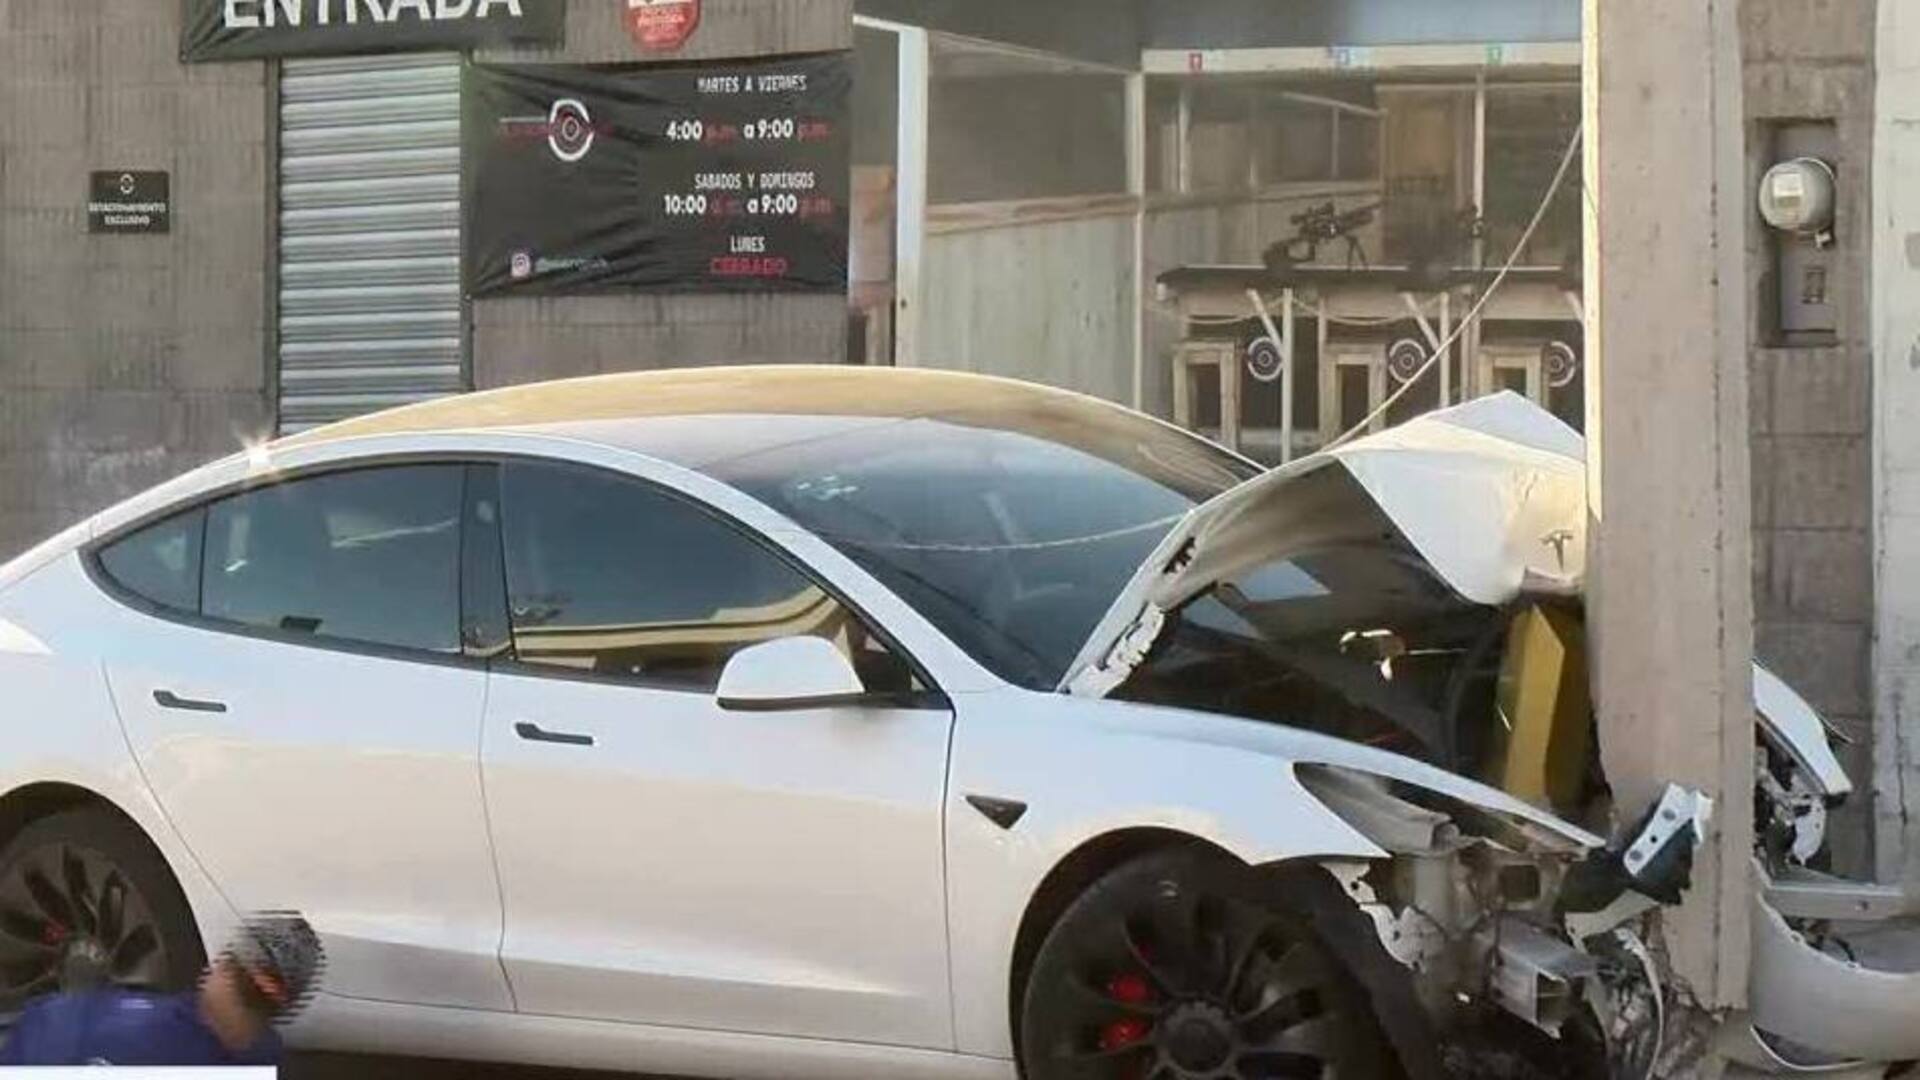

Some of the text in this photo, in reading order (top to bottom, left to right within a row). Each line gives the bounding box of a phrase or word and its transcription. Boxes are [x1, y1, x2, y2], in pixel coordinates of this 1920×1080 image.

[697, 75, 807, 93] MARTES A VIERNES
[666, 119, 703, 140] 4:00
[743, 124, 755, 139] a
[757, 118, 794, 139] 9:00
[694, 171, 815, 190] SABADOS Y DOMINGOS
[664, 194, 707, 215] 10:00
[747, 198, 759, 214] a
[761, 194, 798, 214] 9:00
[730, 234, 766, 252] LUNES
